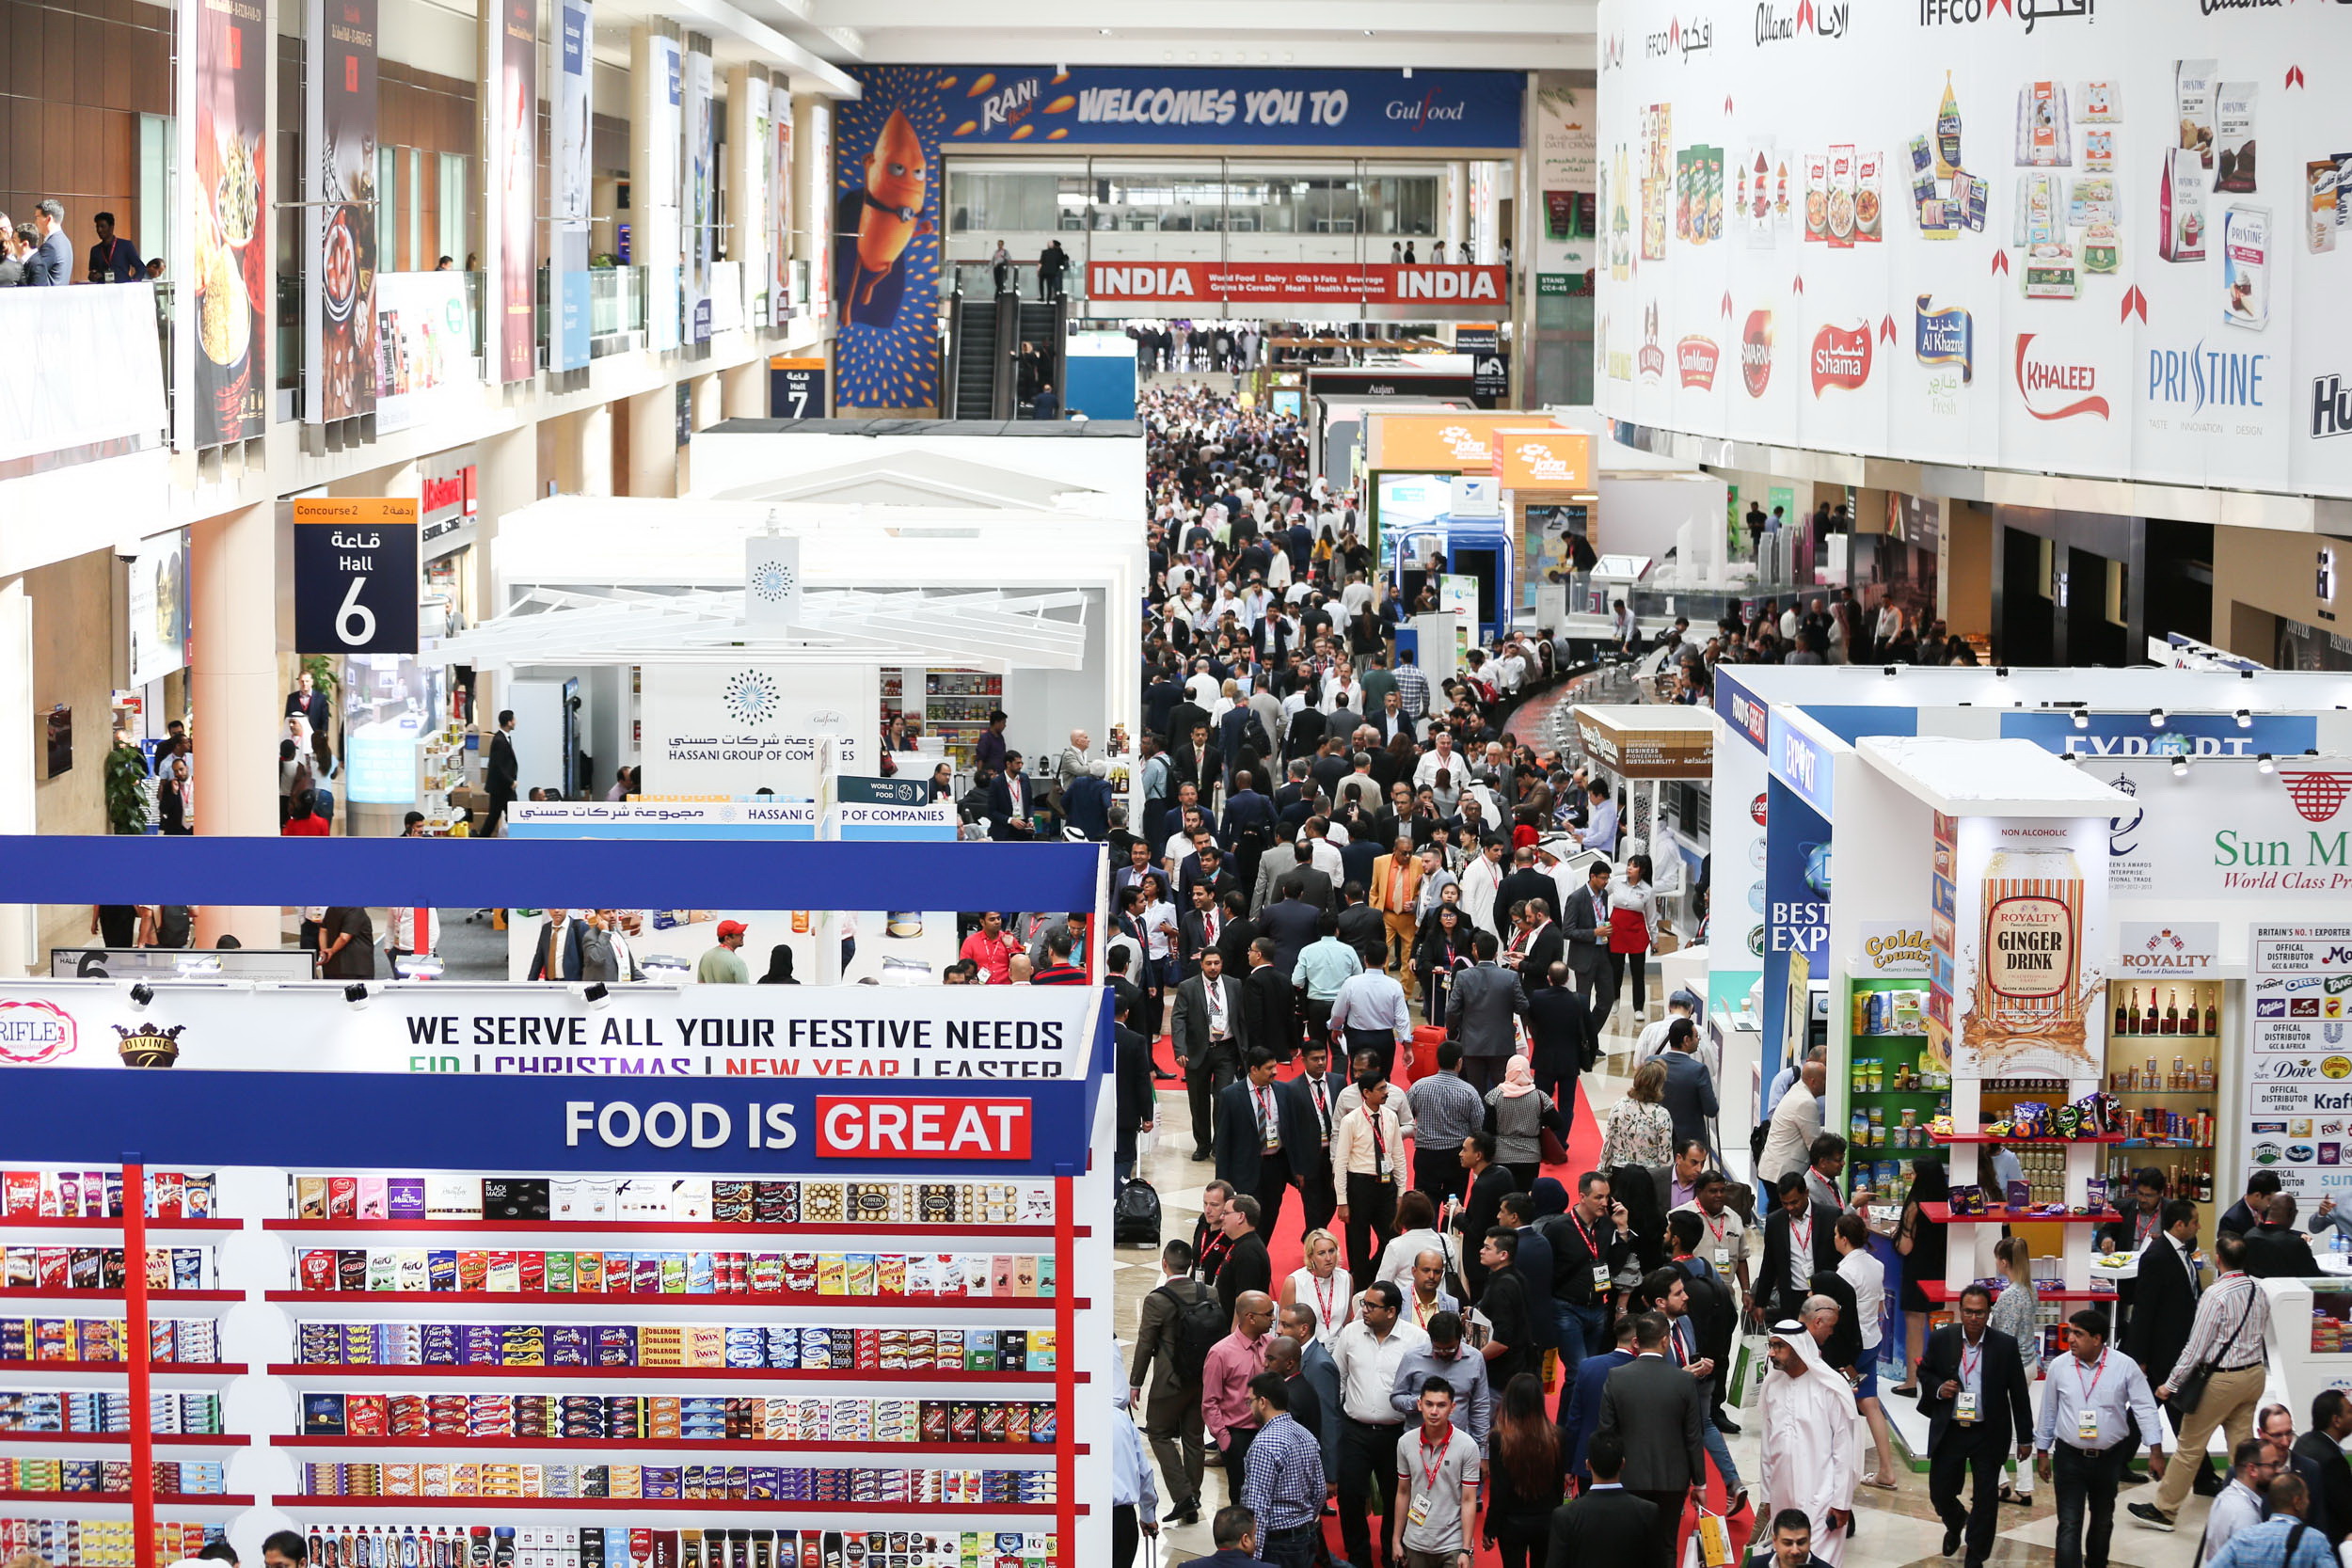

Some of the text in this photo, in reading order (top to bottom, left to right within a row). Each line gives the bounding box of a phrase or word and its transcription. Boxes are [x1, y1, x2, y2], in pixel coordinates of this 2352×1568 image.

[1920, 0, 1981, 26] IFFCO
[1646, 32, 1668, 58] IFFCO
[983, 79, 1039, 133] RANI
[1077, 87, 1349, 127] WELCOMES YOU TO
[1385, 87, 1466, 132] Gulfood
[2232, 228, 2263, 245] PRISTINE
[1094, 267, 1195, 295] INDIA
[1209, 274, 1256, 282] Word Food
[1264, 275, 1287, 284] Dairy
[1295, 275, 1311, 283] Oils
[1321, 275, 1338, 283] Fats
[1397, 270, 1498, 299] INDIA
[1210, 283, 1237, 292] Grans
[1246, 284, 1277, 293] Cereals
[1285, 284, 1306, 293] Meat
[1923, 333, 1964, 354] Al Khazna
[1741, 342, 1775, 366] SWARNA
[1816, 349, 1862, 376] Shama
[787, 372, 810, 381] قاعة
[2027, 361, 2096, 392] KHALEEJ
[2148, 337, 2265, 416] PRISTINE
[1369, 384, 1395, 398] Aujan
[788, 391, 809, 420] 7
[1932, 398, 1956, 415] Fresh
[2148, 419, 2263, 436] TASTE INNOVATION DESIGN
[297, 505, 358, 516] Concourse 2
[383, 505, 389, 515] 2
[330, 531, 381, 548] قاعة
[340, 556, 373, 571] Hall
[335, 577, 376, 646] 6
[814, 711, 839, 727] Gulfood
[1750, 705, 1764, 743] GREAT
[668, 735, 718, 750] حسني
[722, 733, 780, 750] شركات
[669, 750, 854, 761] HASSANI GROUP OF COMES
[519, 806, 704, 820] مجموعة شركات حسني
[748, 809, 803, 820] HASSANI
[851, 810, 867, 819] OF
[871, 810, 945, 821] COMPANIES
[2022, 829, 2068, 837] ALCOHOLIC
[2215, 829, 2291, 867] Sun
[2224, 871, 2352, 890] World Class Pr
[1772, 903, 1831, 925] BEST
[2000, 913, 2058, 923] ROYALTY
[1772, 927, 1830, 952] EXP
[2258, 928, 2294, 937] BRITAIN'S
[2295, 928, 2308, 937] NO.
[2314, 928, 2351, 937] EXPORTER
[1997, 931, 2062, 951] GINGER
[2275, 943, 2304, 952] OFFICAL
[2006, 953, 2053, 970] DRINK
[2122, 954, 2211, 968] ROYALTY
[2267, 953, 2314, 961] DISTRIBUTOR
[2256, 979, 2284, 992] Trident
[2286, 978, 2322, 991] OREO
[406, 1016, 1064, 1051] WE SERVE ALL YOUR FESTIVE NEEDS
[2273, 1023, 2301, 1032] OFFICAL
[124, 1037, 171, 1052] DIVINE
[2265, 1033, 2312, 1041] DISTRIBUTOR
[2273, 1060, 2317, 1078] Dove
[2269, 1085, 2298, 1094] OFFICAL
[2262, 1095, 2308, 1103] DISTRIBUTOR
[565, 1101, 1025, 1152] FOOD IS GREAT
[72, 1258, 99, 1273] SNICKERS
[145, 1259, 167, 1270] WIX
[430, 1261, 455, 1274] YORKIE
[607, 1271, 630, 1282] Skittles
[634, 1271, 659, 1282] Skittles
[645, 1337, 681, 1345] TOBLERONE
[1027, 1537, 1041, 1548] PG
